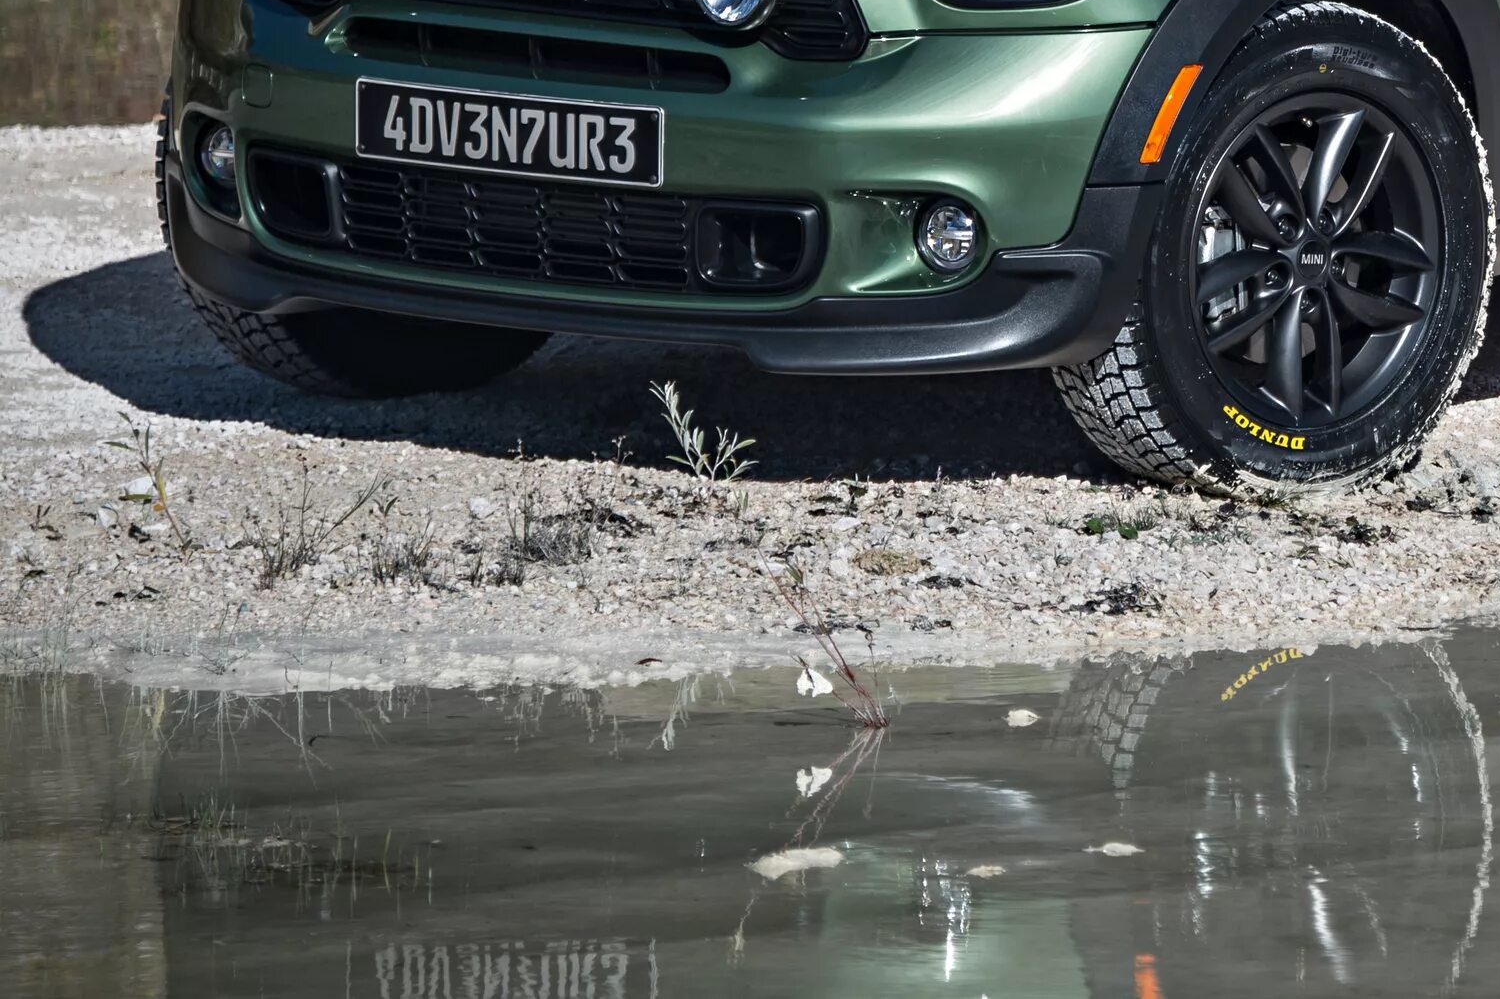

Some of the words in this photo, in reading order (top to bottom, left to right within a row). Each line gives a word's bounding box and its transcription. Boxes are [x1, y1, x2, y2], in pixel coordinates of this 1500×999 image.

[383, 95, 636, 174] 4DV3N7UR3
[1301, 253, 1324, 265] MINI
[1222, 405, 1306, 450] DUNLOP
